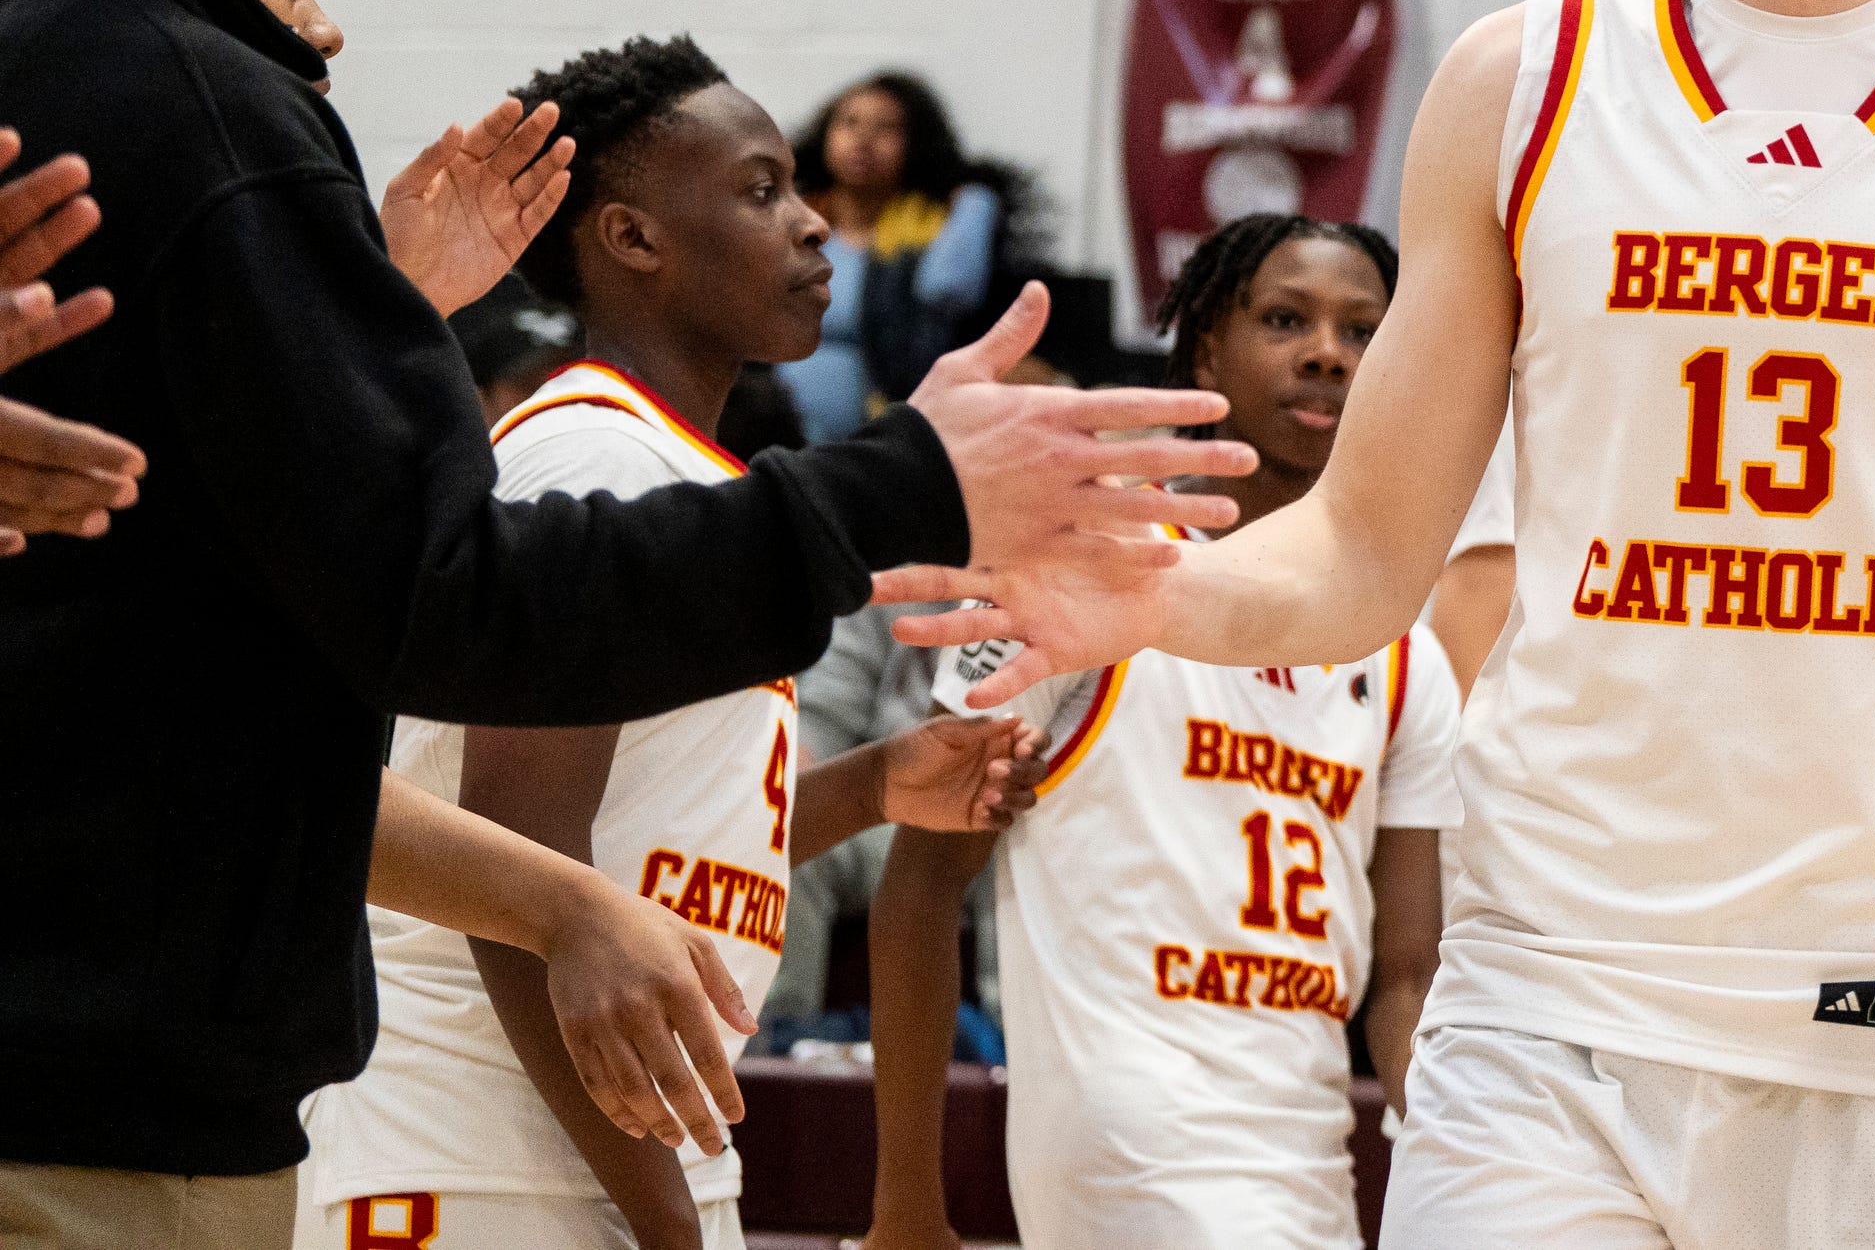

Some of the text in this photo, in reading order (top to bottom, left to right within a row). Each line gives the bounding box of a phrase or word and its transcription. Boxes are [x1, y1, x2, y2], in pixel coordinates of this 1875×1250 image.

[1675, 347, 1842, 519] 13
[763, 716, 789, 855] 4
[1239, 807, 1330, 940] 12
